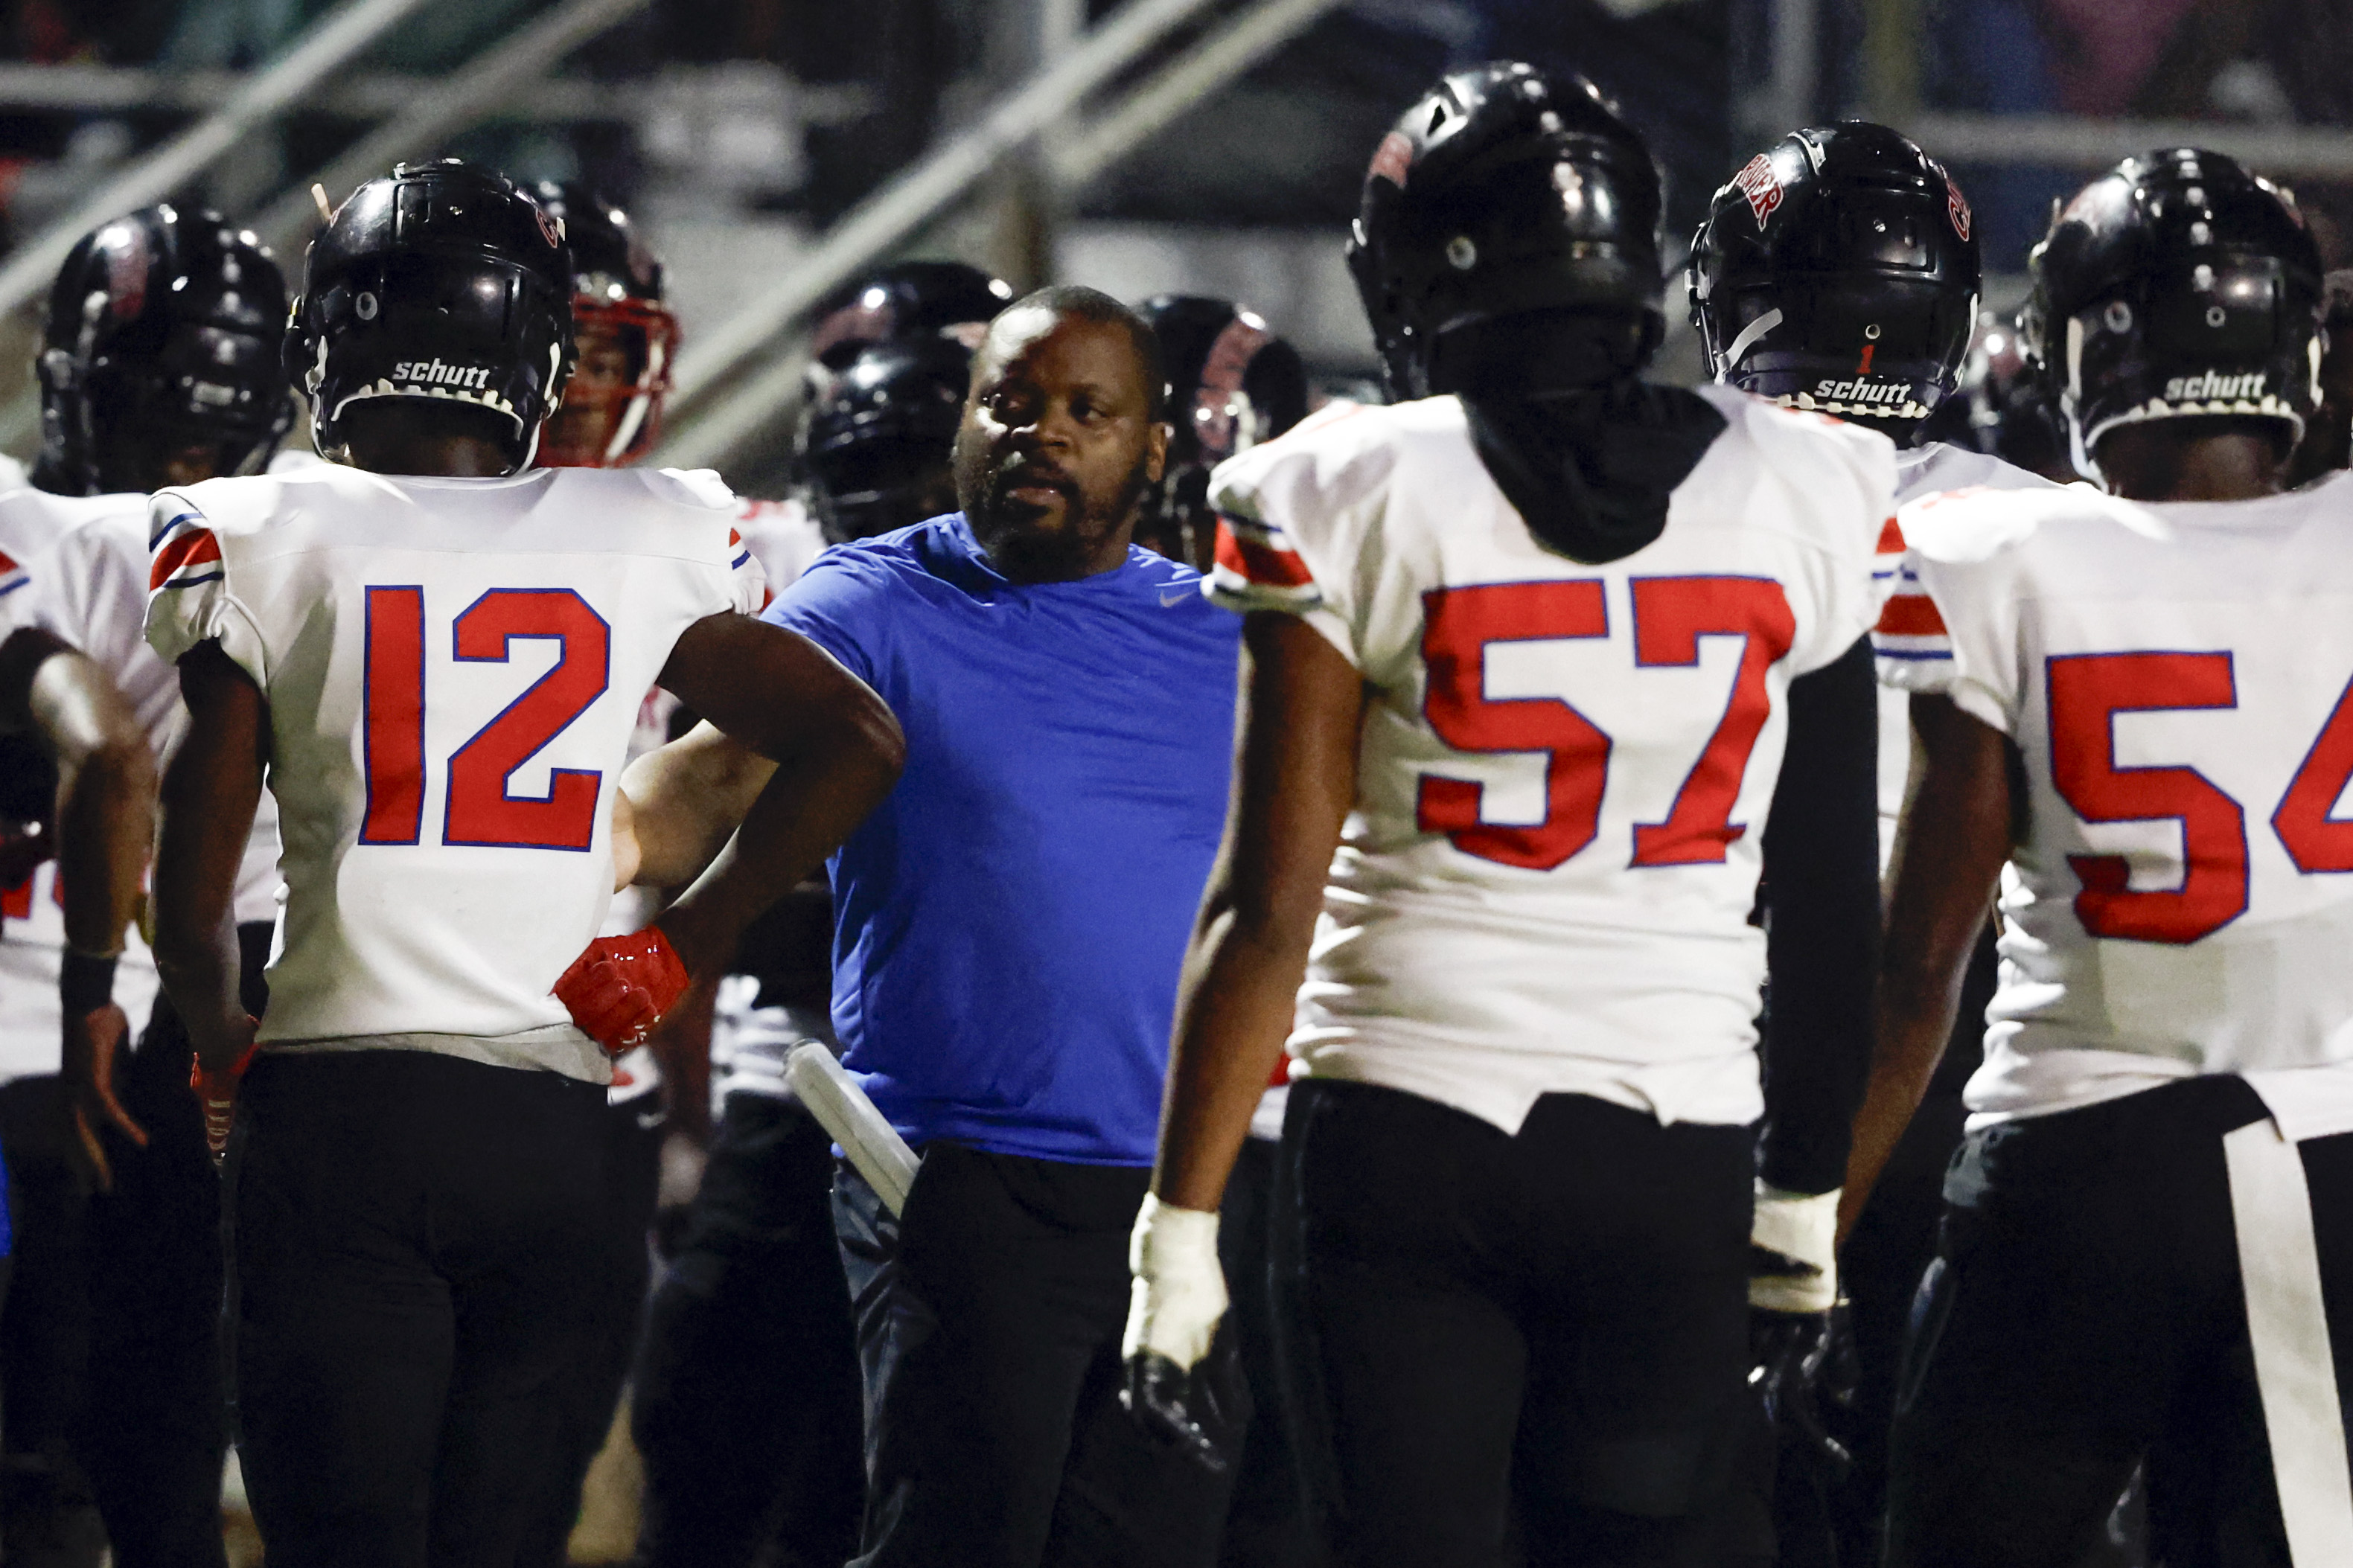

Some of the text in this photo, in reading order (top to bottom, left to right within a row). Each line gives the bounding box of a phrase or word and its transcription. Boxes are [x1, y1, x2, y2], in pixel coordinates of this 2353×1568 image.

[392, 357, 490, 389] schutt
[1856, 345, 1875, 374] 1
[1813, 377, 1912, 403] schutt
[2164, 369, 2267, 400] schutt
[358, 585, 611, 852] 12
[1417, 574, 1796, 871] 57
